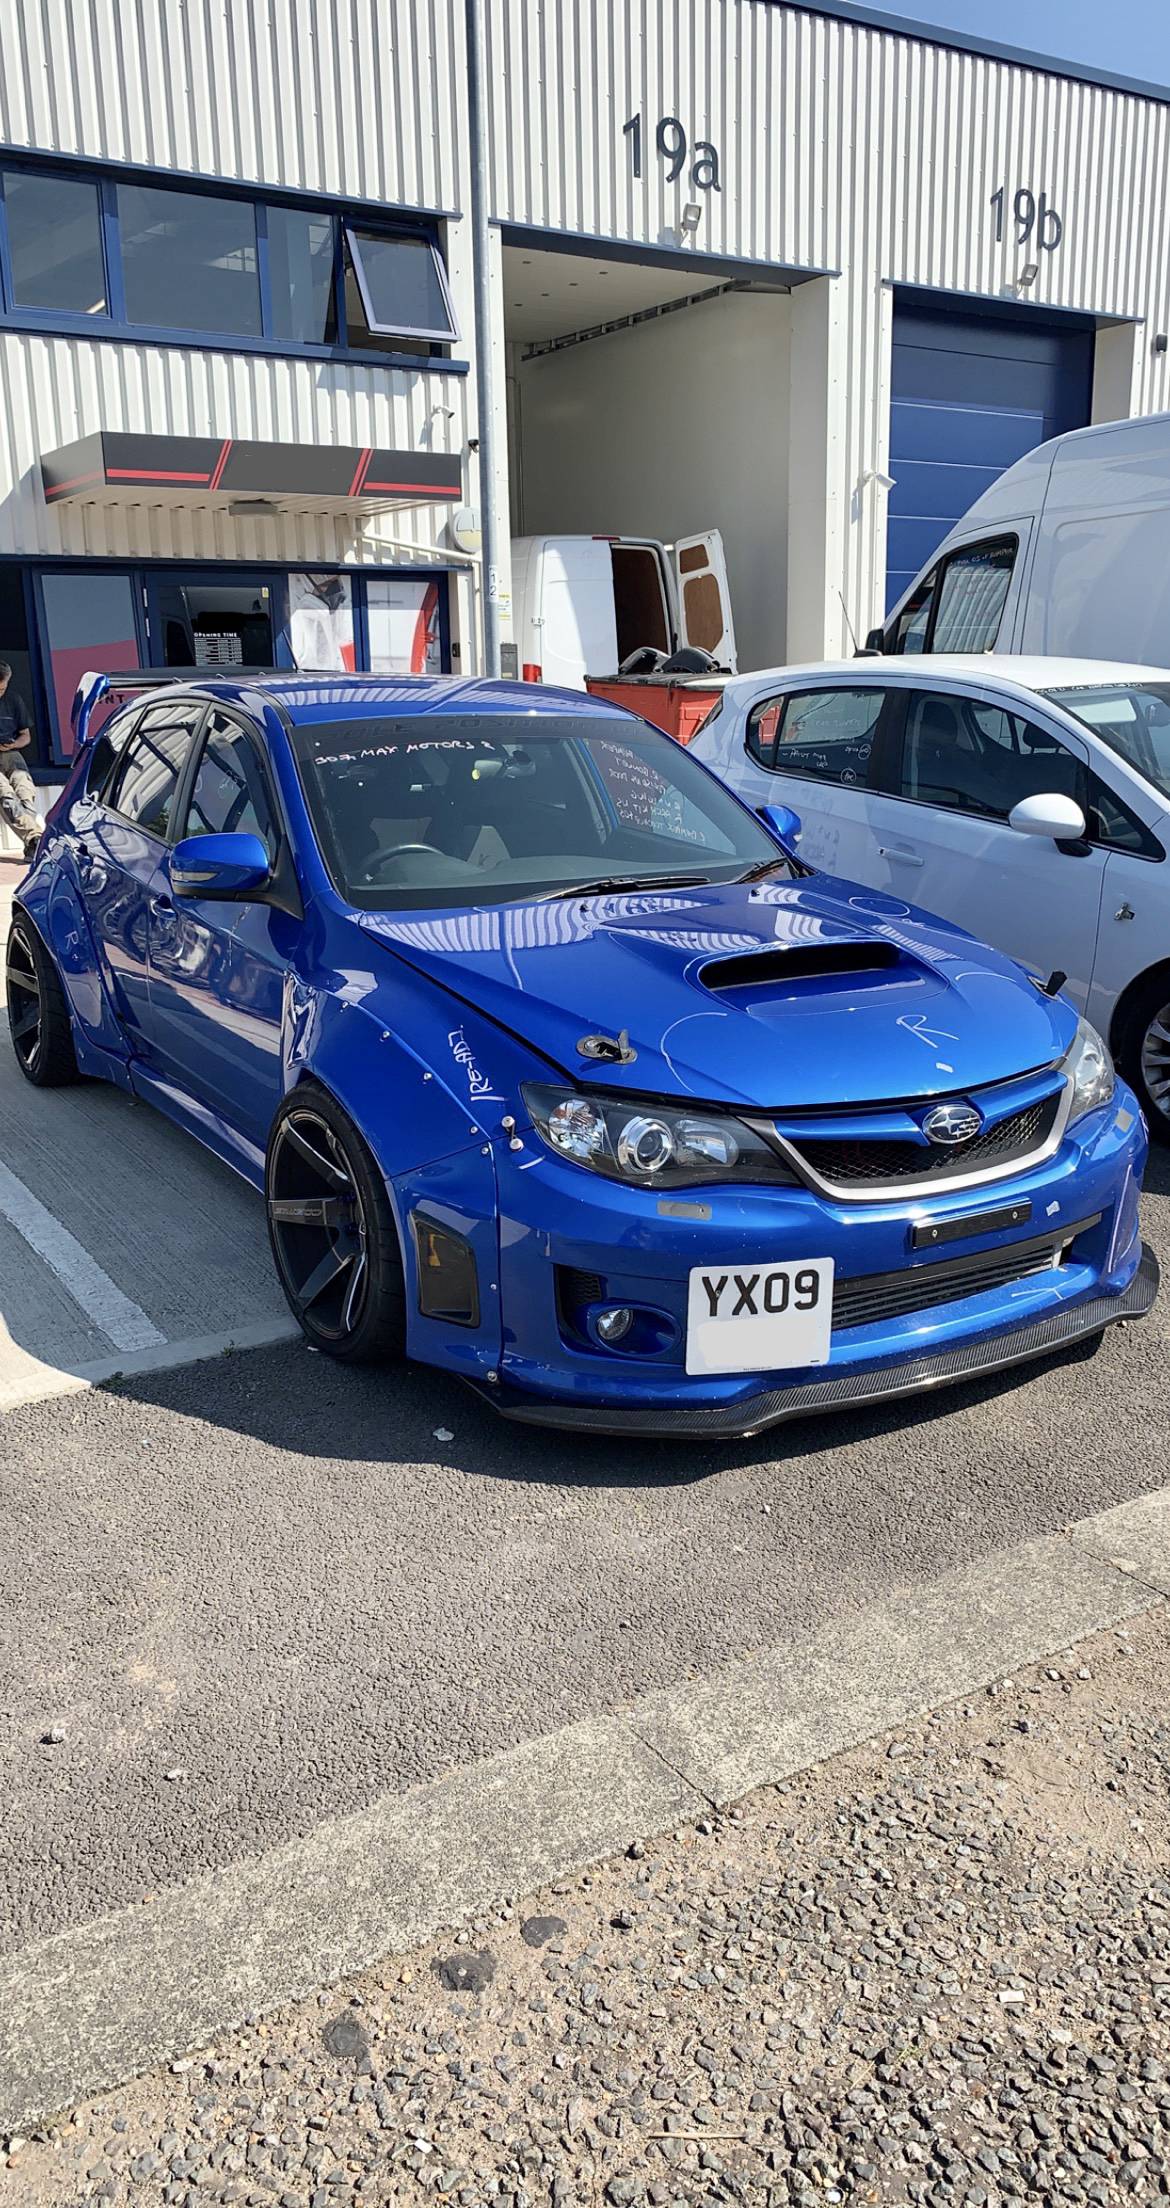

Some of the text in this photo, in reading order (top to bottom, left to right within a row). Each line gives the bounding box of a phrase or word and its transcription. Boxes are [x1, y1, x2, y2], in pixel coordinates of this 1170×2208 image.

[623, 112, 721, 192] 19a
[990, 186, 1063, 252] 19b
[896, 1013, 959, 1049] R
[701, 1268, 820, 1317] YX09
